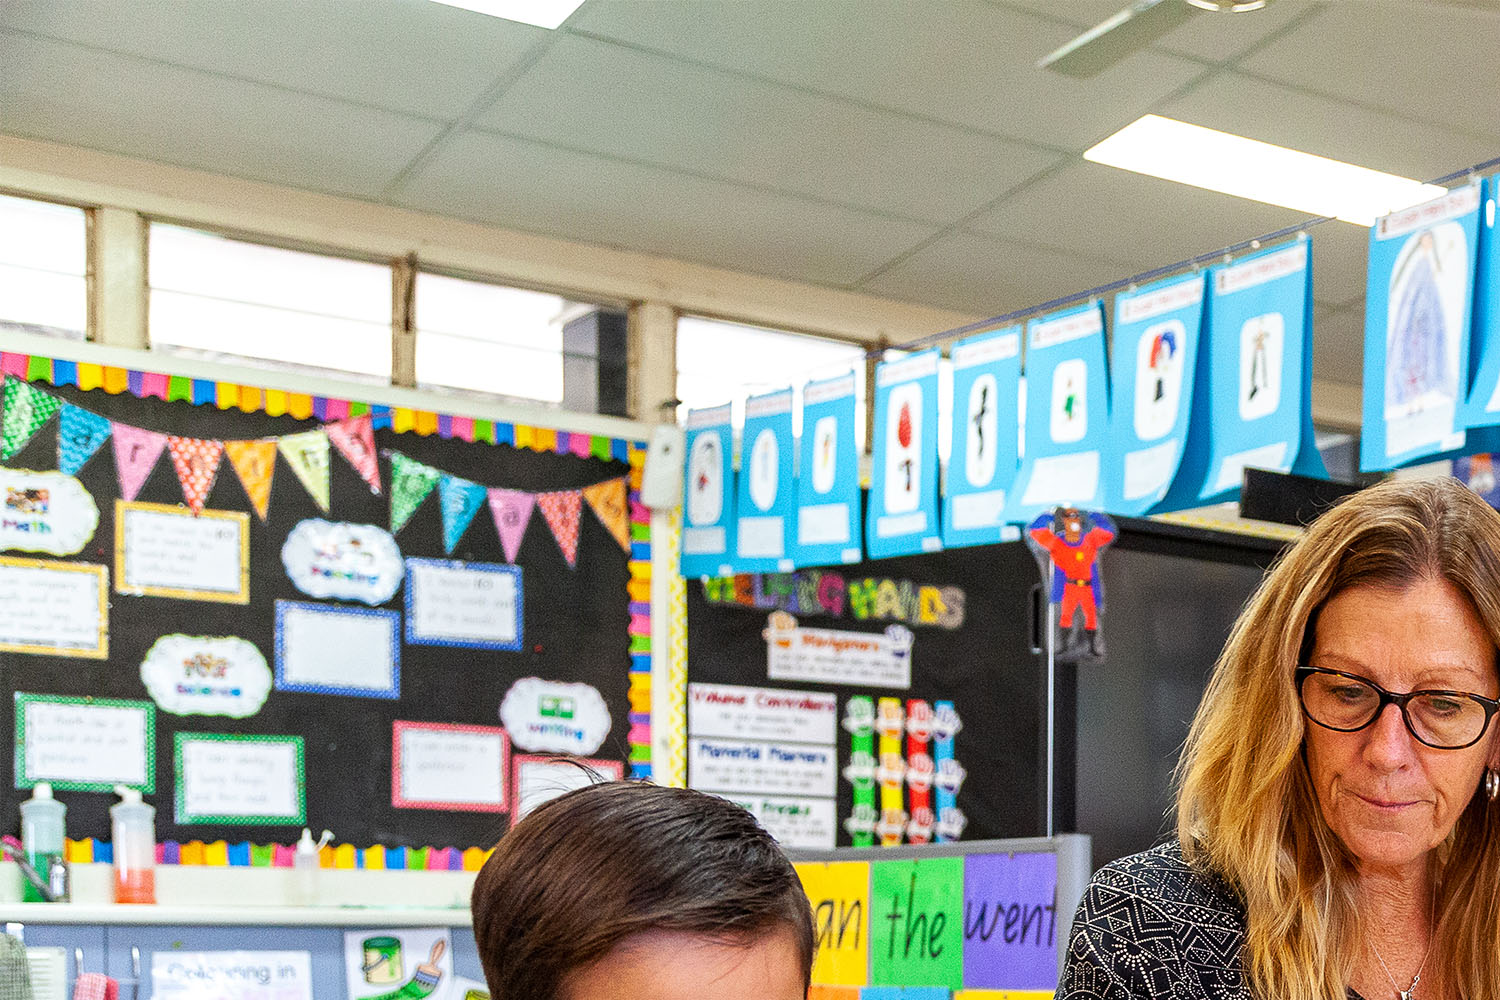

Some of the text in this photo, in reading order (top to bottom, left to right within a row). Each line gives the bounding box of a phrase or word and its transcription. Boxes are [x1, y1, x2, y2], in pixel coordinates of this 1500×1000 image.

[849, 577, 967, 630] HANDS
[886, 870, 947, 959] the
[964, 885, 1058, 948] went
